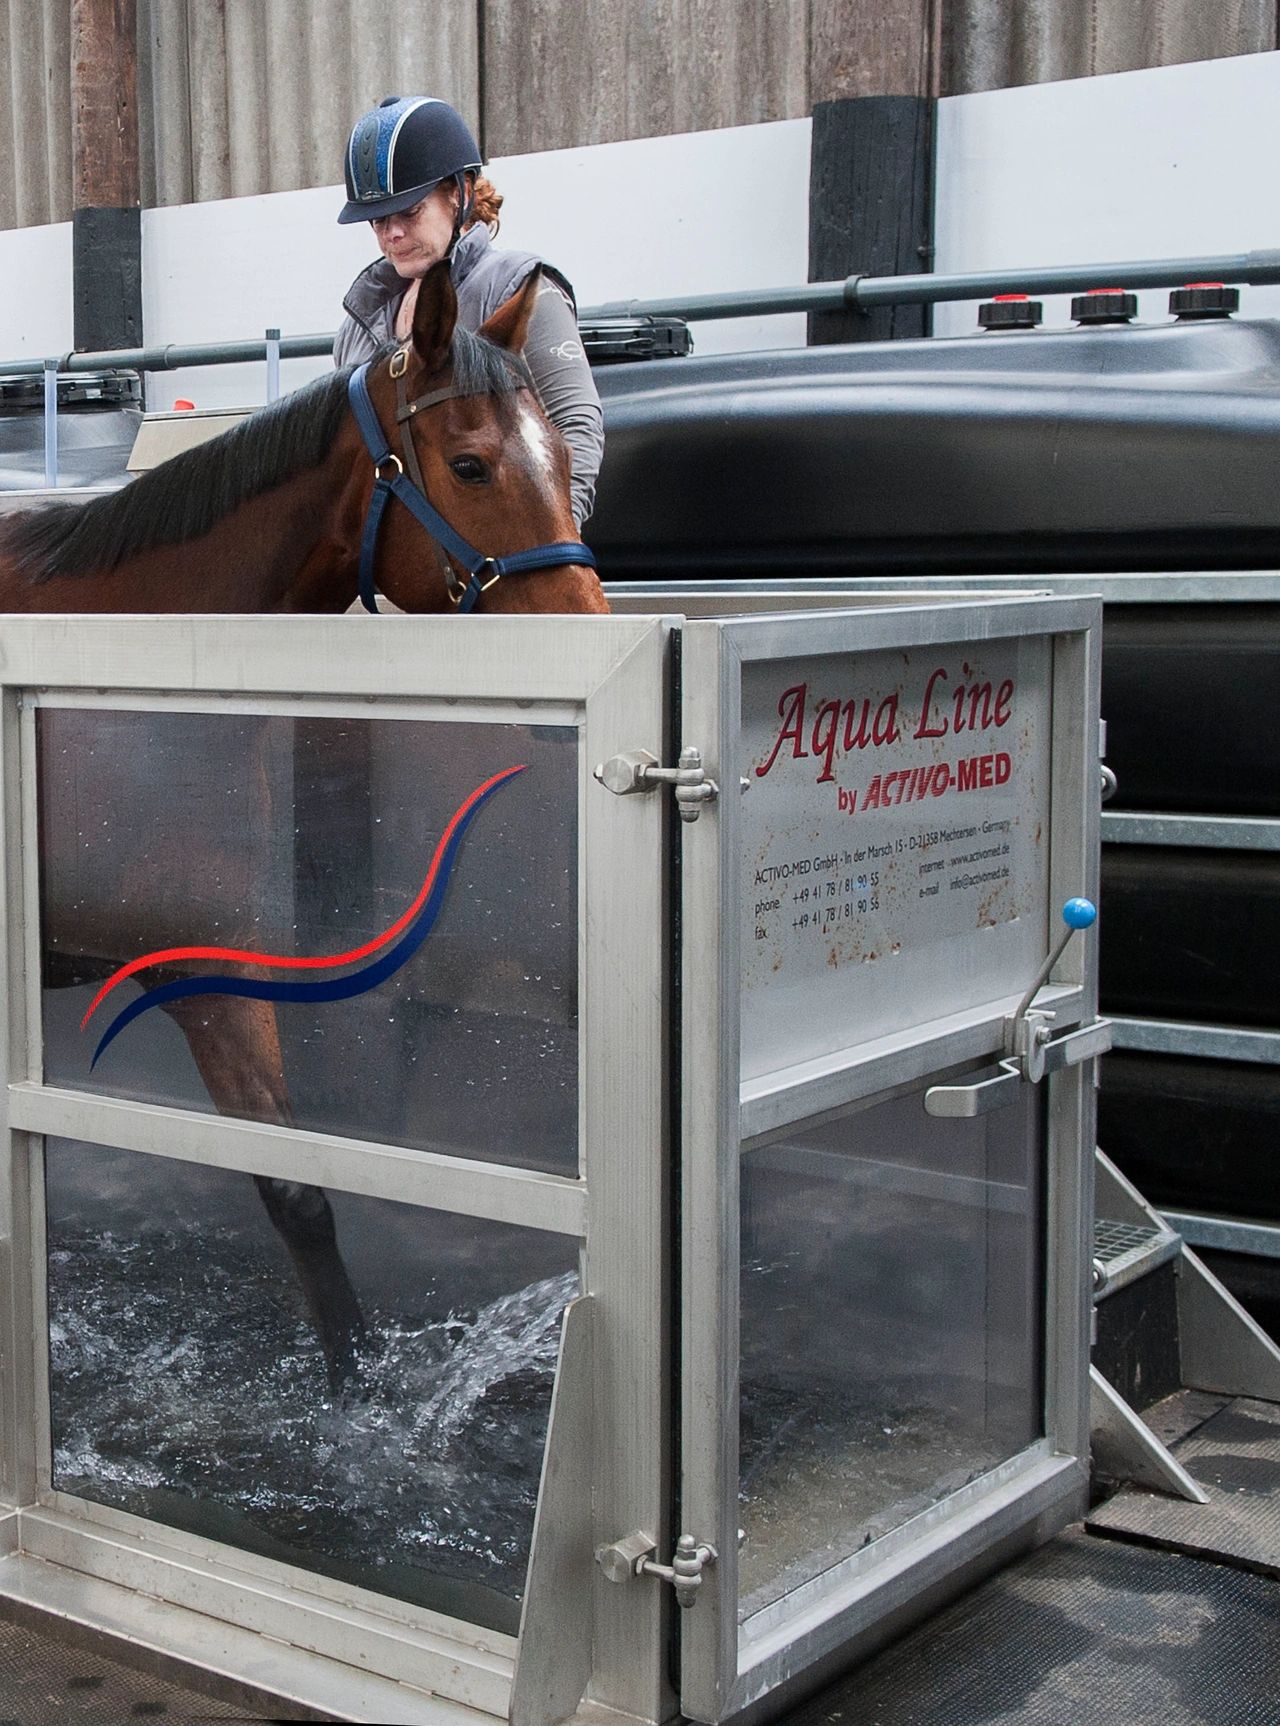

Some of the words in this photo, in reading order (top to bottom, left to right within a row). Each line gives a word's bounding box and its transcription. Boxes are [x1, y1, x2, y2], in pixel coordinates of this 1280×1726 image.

[756, 682, 899, 784] Aqua
[913, 662, 1014, 741] Line
[838, 786, 858, 815] by
[860, 752, 1012, 812] ACTIVO-MED
[754, 860, 811, 885] ACTIVO-MED
[813, 853, 838, 872] GmbH
[845, 851, 852, 865] In
[854, 849, 866, 862] der
[867, 842, 892, 859] Marsch
[895, 839, 903, 853] 15
[982, 820, 1010, 834] Germany
[755, 899, 780, 918] phone
[792, 888, 809, 904] +49
[813, 885, 821, 899] 41
[826, 881, 836, 897] 78
[845, 878, 854, 893] 81
[857, 874, 867, 889] 90
[919, 881, 939, 898] e-mail
[755, 926, 768, 940] fax
[792, 913, 809, 930] +49
[812, 911, 821, 925] 41
[825, 907, 835, 922] 78
[845, 902, 853, 917] 81
[857, 899, 867, 913] 90
